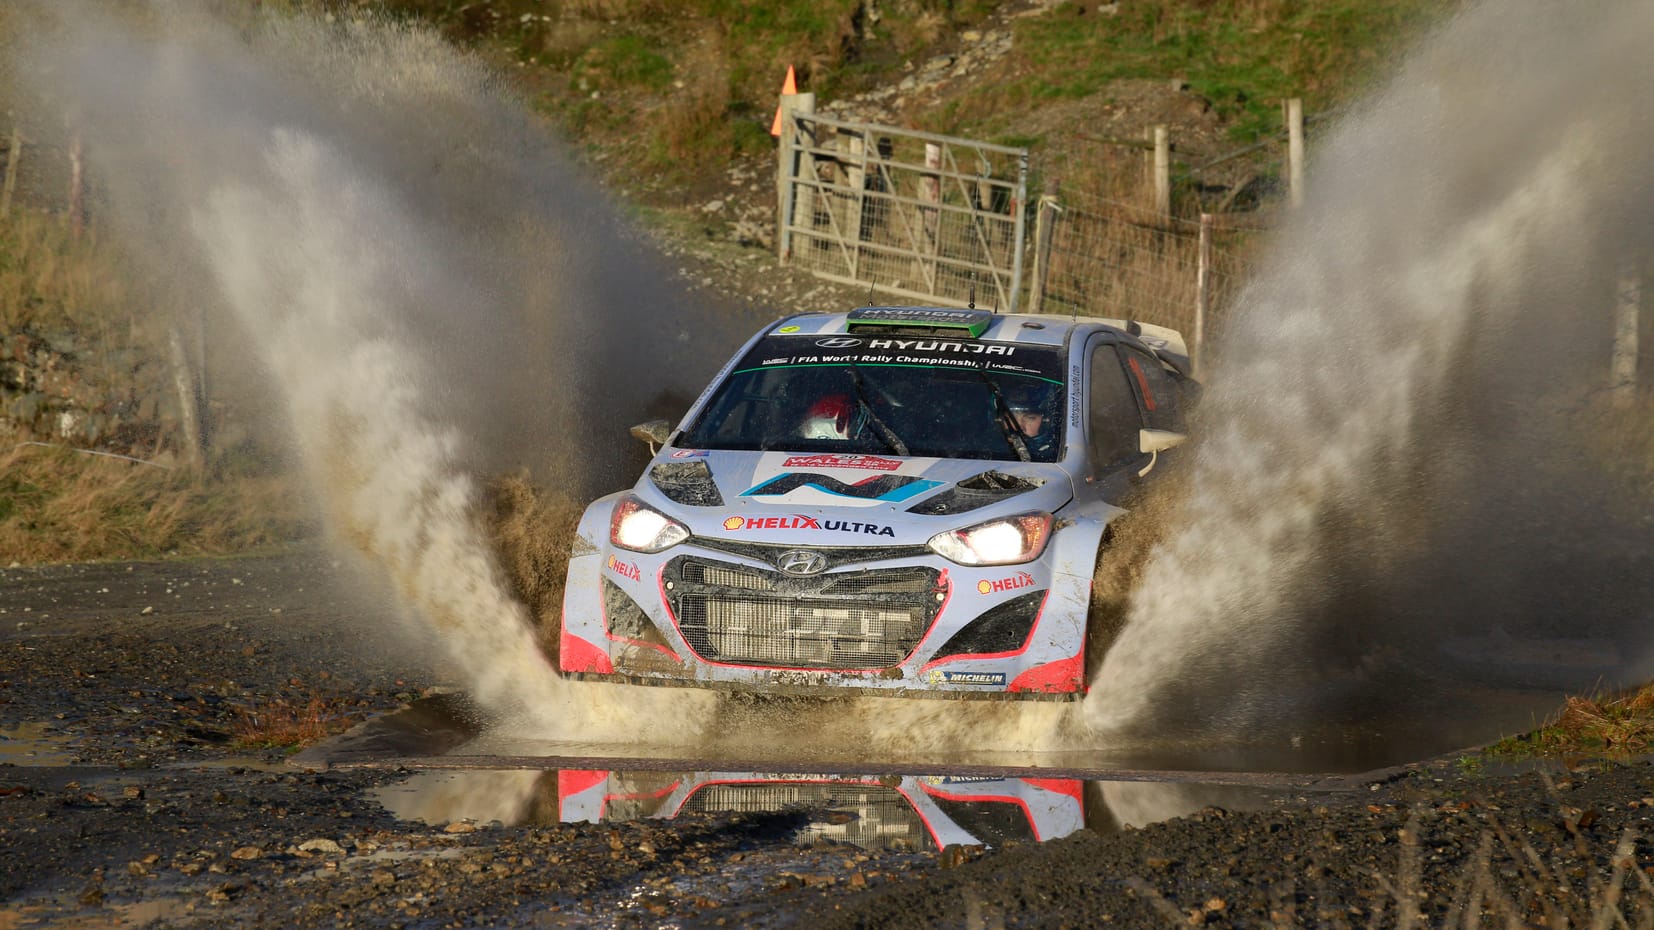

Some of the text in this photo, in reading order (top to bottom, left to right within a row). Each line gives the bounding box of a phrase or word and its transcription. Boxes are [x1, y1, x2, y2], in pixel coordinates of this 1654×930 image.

[864, 310, 974, 319] HYUNDAI
[869, 339, 1016, 356] HYUNDAI
[861, 355, 893, 365] Rally
[896, 356, 984, 368] Championshi
[790, 457, 863, 465] WALES
[746, 514, 896, 538] HELIX ULTRA
[613, 559, 641, 582] HELIX
[991, 570, 1037, 592] HELIX
[950, 674, 1004, 682] MICHELIN
